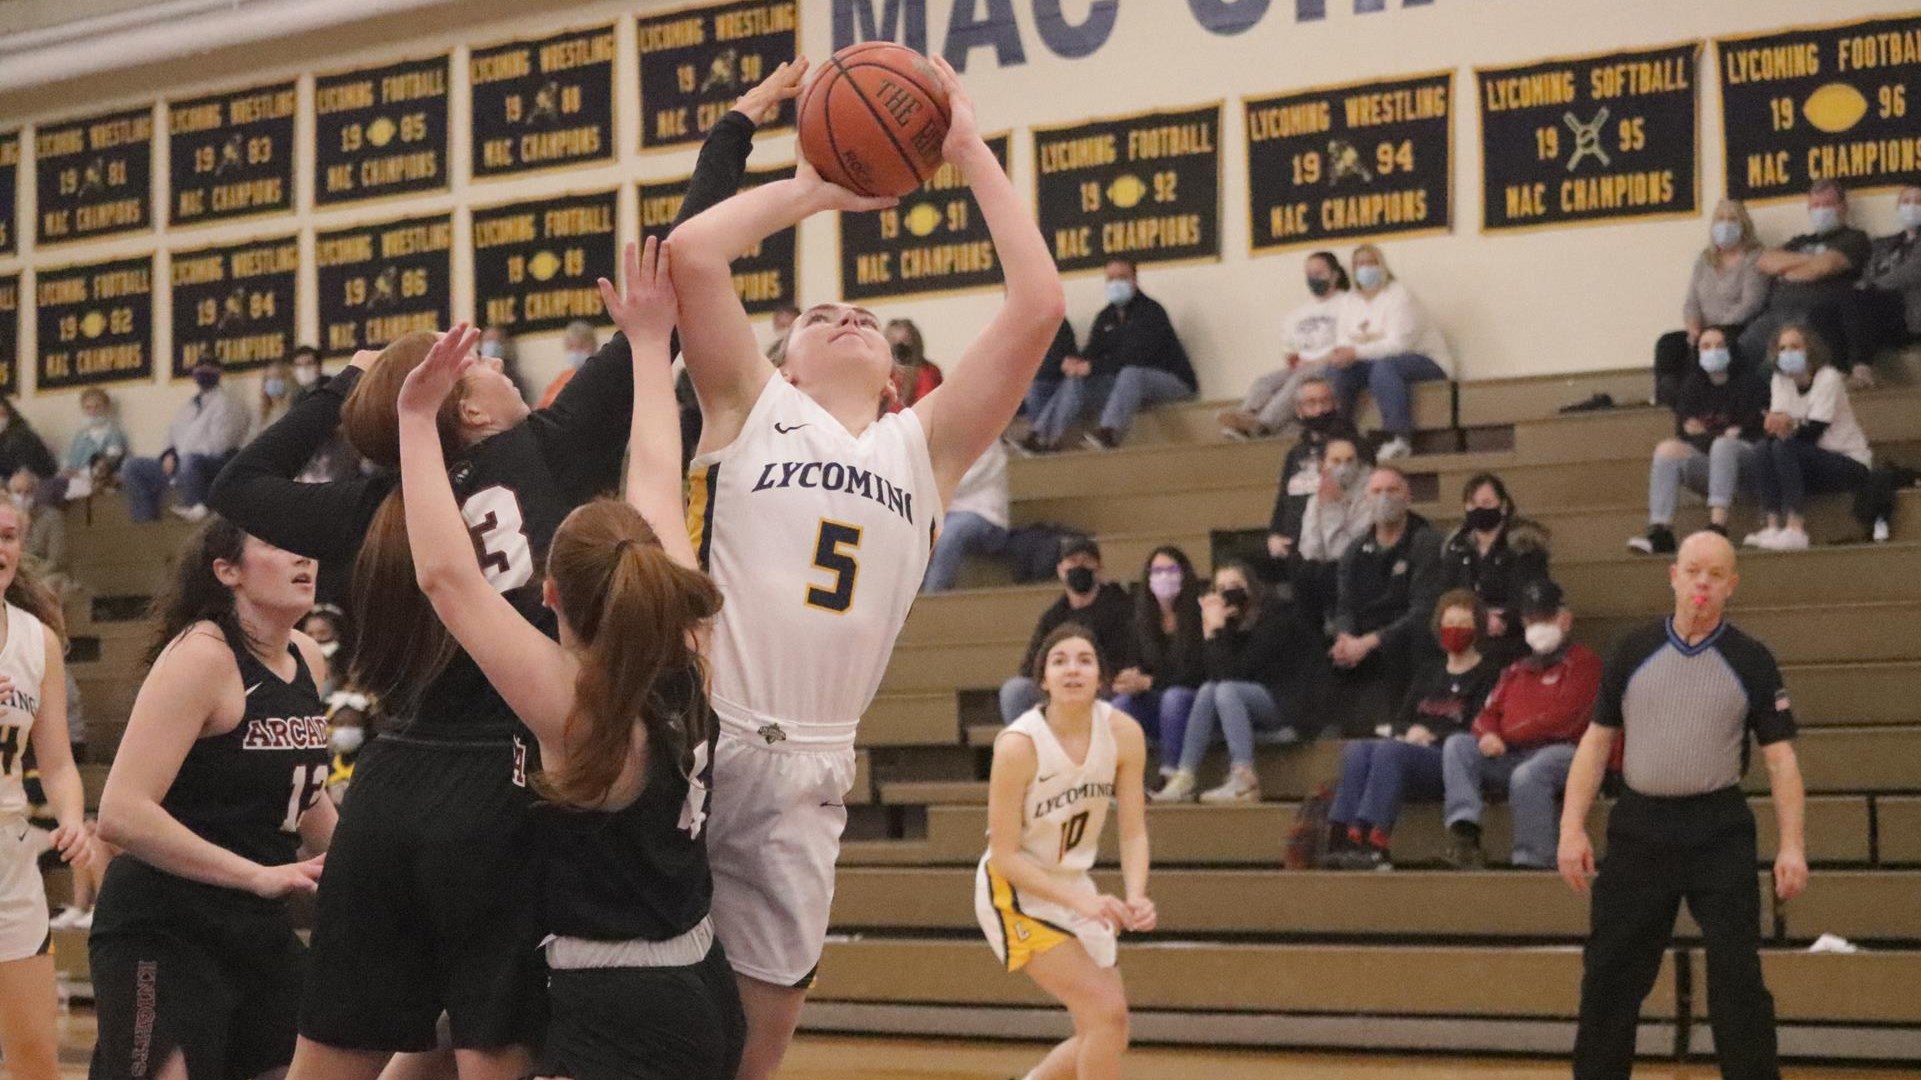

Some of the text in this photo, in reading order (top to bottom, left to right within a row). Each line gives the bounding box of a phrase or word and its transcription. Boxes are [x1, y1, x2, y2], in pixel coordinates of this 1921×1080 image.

[677, 66, 695, 93] 19
[1486, 57, 1688, 112] LYCOMING SOFTBALL
[1727, 43, 1819, 85] LYCOMING
[505, 95, 521, 122] 19
[876, 79, 923, 128] THE
[1249, 86, 1446, 141] LYCOMING WRESTLING
[1770, 84, 1906, 132] 19 96
[341, 113, 427, 152] 19 85
[1041, 124, 1213, 173] LYCOMING FOOTBALL
[1535, 117, 1645, 161] 19 95
[195, 137, 271, 173] 19 83
[1292, 140, 1414, 186] 19 94
[1747, 151, 1790, 188] MAC
[60, 168, 78, 195] 19
[1080, 171, 1177, 213] 19 92
[1505, 171, 1673, 219] MAC CHAMPIONS
[947, 200, 968, 231] 91
[1270, 189, 1428, 239] MAC CHAMPIONS
[1056, 214, 1199, 260] MAC CHAMPIONS
[508, 256, 523, 284] 19
[857, 240, 993, 284] MAC CHAMPIONS
[60, 316, 78, 340] 19
[459, 484, 535, 595] 3
[803, 515, 863, 616] 5
[1058, 810, 1090, 863] 10
[1014, 922, 1030, 941] L
